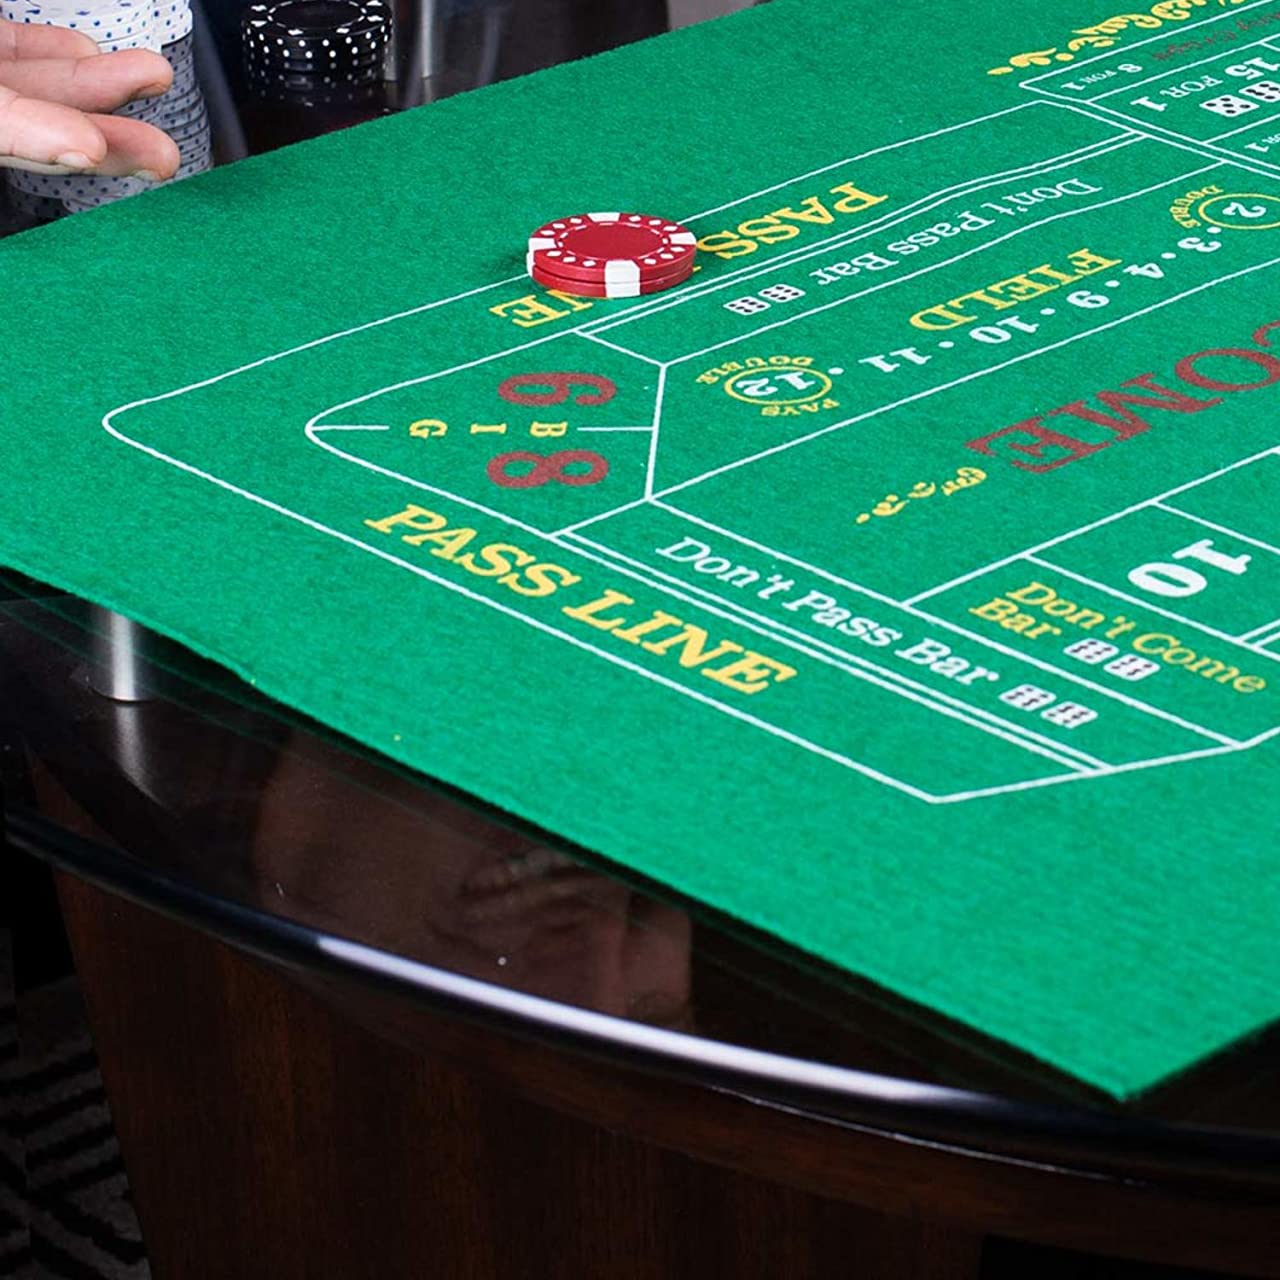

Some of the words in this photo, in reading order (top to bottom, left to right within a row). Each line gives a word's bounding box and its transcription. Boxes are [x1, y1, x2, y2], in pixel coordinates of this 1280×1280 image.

[1082, 70, 1117, 85] FOR
[1118, 64, 1142, 73] 8
[1225, 57, 1280, 80] 15
[1061, 81, 1085, 91] 1
[1160, 75, 1223, 98] FOR
[1130, 96, 1167, 112] 1
[1244, 142, 1269, 153] 1
[981, 178, 1102, 215] Don't
[696, 182, 888, 260] PASS
[1222, 202, 1266, 219] 2
[887, 210, 995, 255] Pass
[1177, 237, 1222, 252] 3
[809, 252, 899, 285] Bar
[1123, 263, 1165, 280] 4
[909, 248, 1121, 330] FIELD
[1067, 291, 1109, 308] 9
[969, 316, 1040, 344] 10
[696, 355, 815, 386] DOUBLE
[859, 347, 932, 373] 11
[498, 372, 617, 407] 6
[736, 371, 815, 397] 12
[761, 398, 840, 417] PAYS
[486, 449, 609, 489] 8
[1127, 539, 1252, 597] 10
[365, 504, 582, 597] PASS
[562, 589, 797, 694] LINE
[656, 537, 795, 600] Don't
[781, 590, 903, 648] Pass
[896, 638, 999, 686] Bar
[969, 597, 1061, 639] Bar
[1006, 581, 1136, 638] Don't
[1131, 633, 1266, 693] Come
